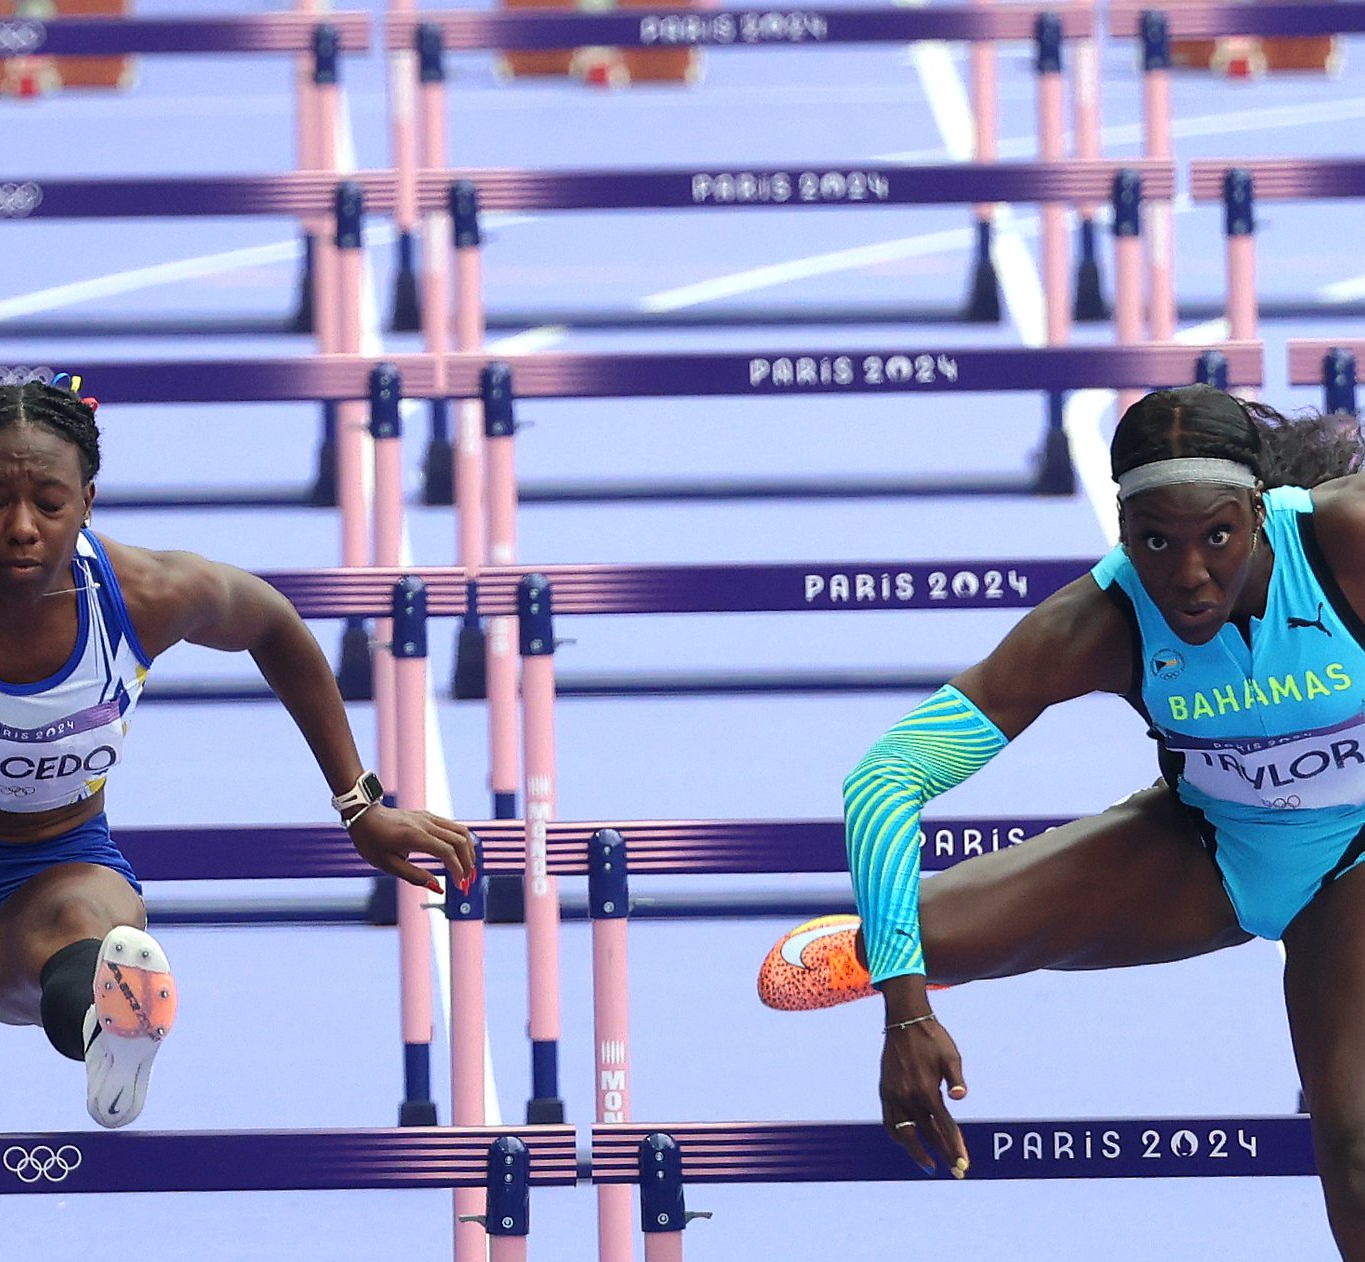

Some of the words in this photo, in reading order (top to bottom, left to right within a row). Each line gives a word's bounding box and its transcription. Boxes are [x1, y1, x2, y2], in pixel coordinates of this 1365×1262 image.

[862, 354, 958, 384] 2024
[927, 570, 1028, 600] 2024
[1168, 662, 1352, 721] BAHAMAS
[35, 720, 74, 740] 2024
[1142, 1130, 1258, 1159] 2024
